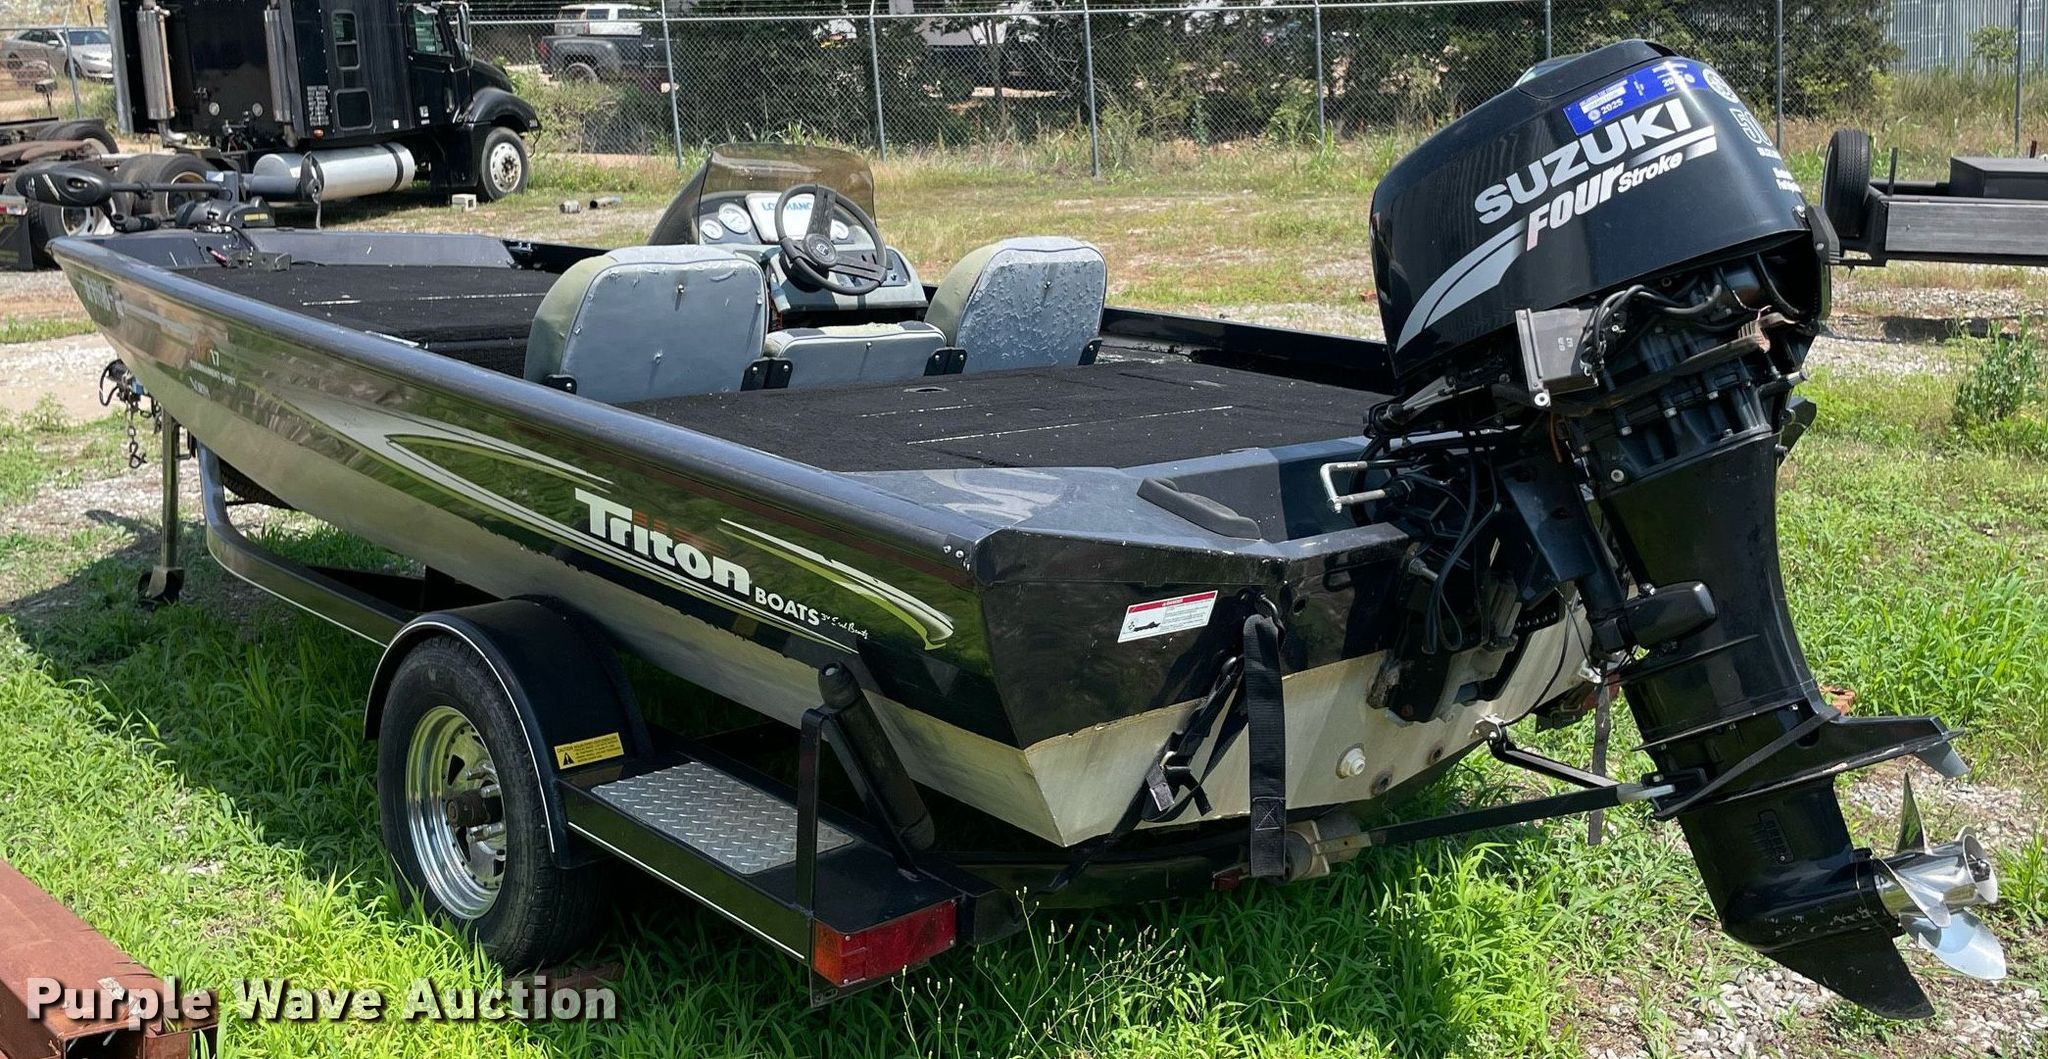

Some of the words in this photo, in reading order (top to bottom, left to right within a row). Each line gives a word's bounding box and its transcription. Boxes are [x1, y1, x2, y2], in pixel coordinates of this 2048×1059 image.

[1601, 98, 1624, 115] 2025
[1474, 98, 1692, 225] SUZUKI
[1617, 152, 1683, 194] Stroke
[575, 488, 751, 596] Triton
[755, 586, 820, 626] BOATS
